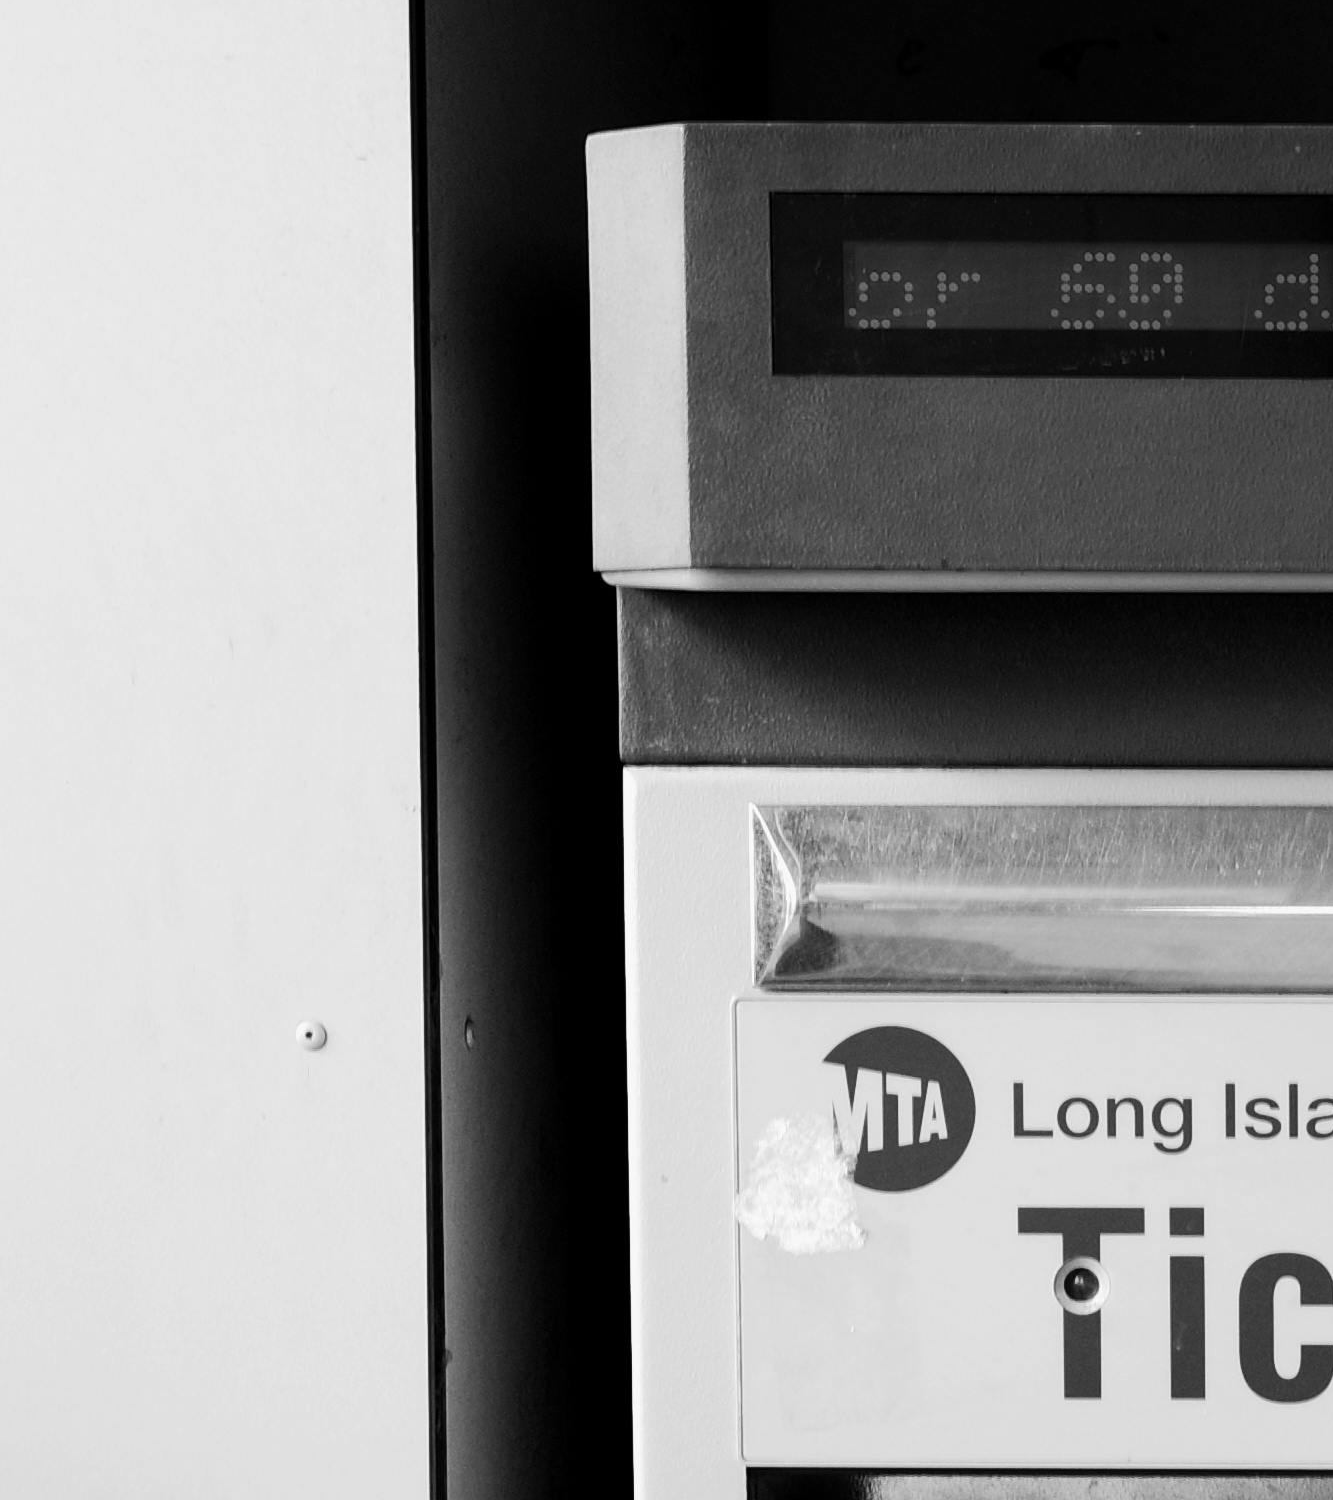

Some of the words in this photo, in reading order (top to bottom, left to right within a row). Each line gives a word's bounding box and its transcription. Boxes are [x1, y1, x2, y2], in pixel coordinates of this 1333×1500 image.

[1051, 253, 1184, 330] 60
[824, 1061, 948, 1153] MTA
[1014, 1083, 1192, 1153] Long
